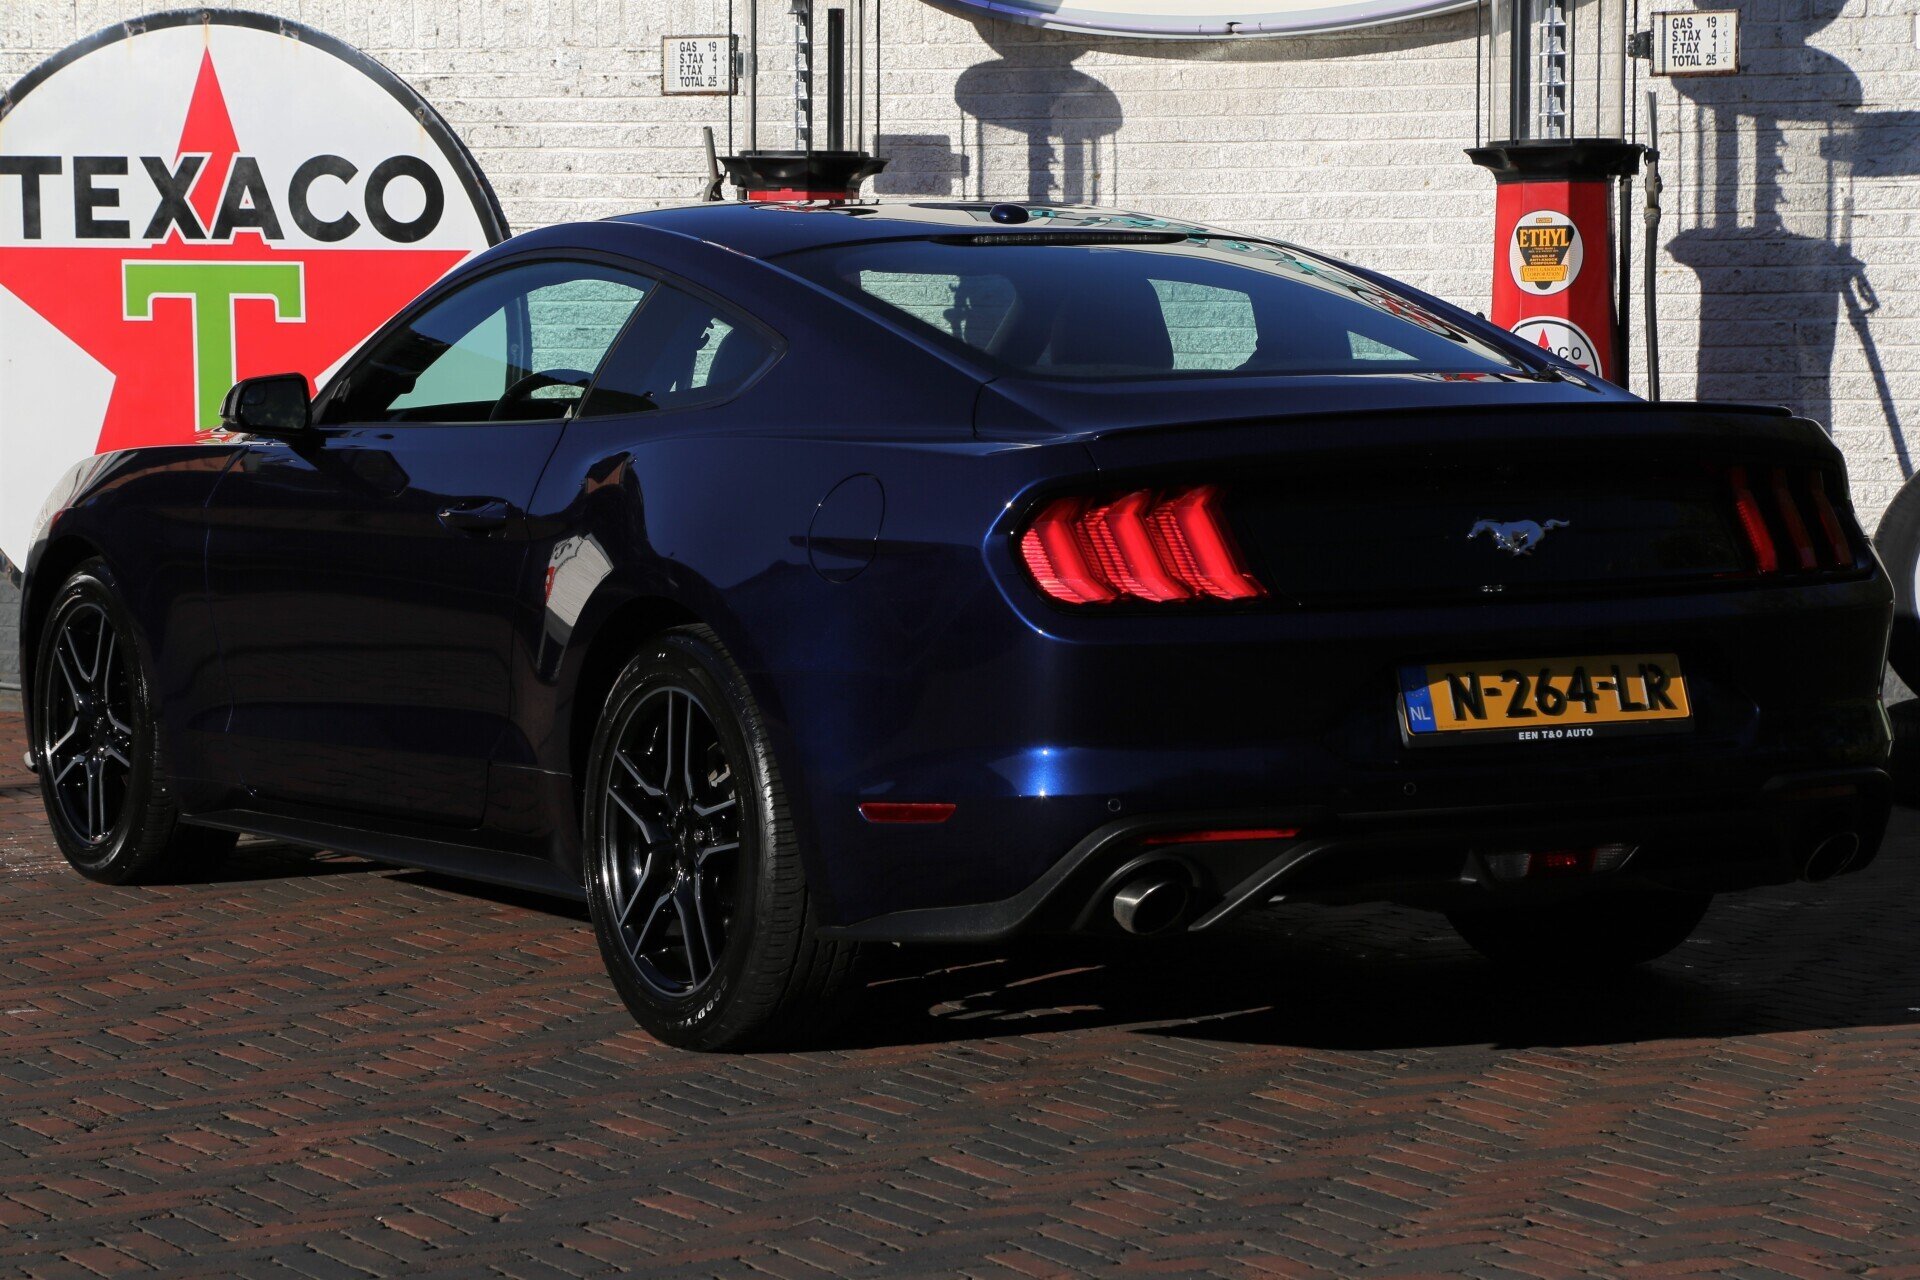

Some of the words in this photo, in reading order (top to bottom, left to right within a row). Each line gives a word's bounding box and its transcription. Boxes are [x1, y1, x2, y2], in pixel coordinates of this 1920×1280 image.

[1672, 17, 1693, 29] GAS
[1706, 16, 1717, 28] 19
[1672, 29, 1701, 42] S.TAX
[1711, 29, 1717, 40] 4
[679, 41, 697, 53] GAS
[708, 41, 717, 53] 19
[1672, 42, 1699, 54] F.TAX
[1712, 41, 1717, 52] 1
[679, 53, 704, 64] S.TAX
[712, 53, 718, 64] 4
[1672, 54, 1702, 67] TOTAL
[1706, 54, 1717, 65] 25
[679, 65, 703, 76] F.TAX
[713, 65, 717, 75] 1
[679, 76, 705, 88] TOTAL
[708, 76, 718, 87] 25
[0, 154, 445, 244] TEXACO
[1519, 228, 1569, 247] ETHYL
[123, 261, 305, 431] T
[1446, 663, 1678, 721] N-264-LR
[1409, 706, 1431, 721] NL
[1518, 731, 1539, 740] EEN
[1541, 730, 1563, 739] T&O
[1566, 728, 1594, 738] AUTO
